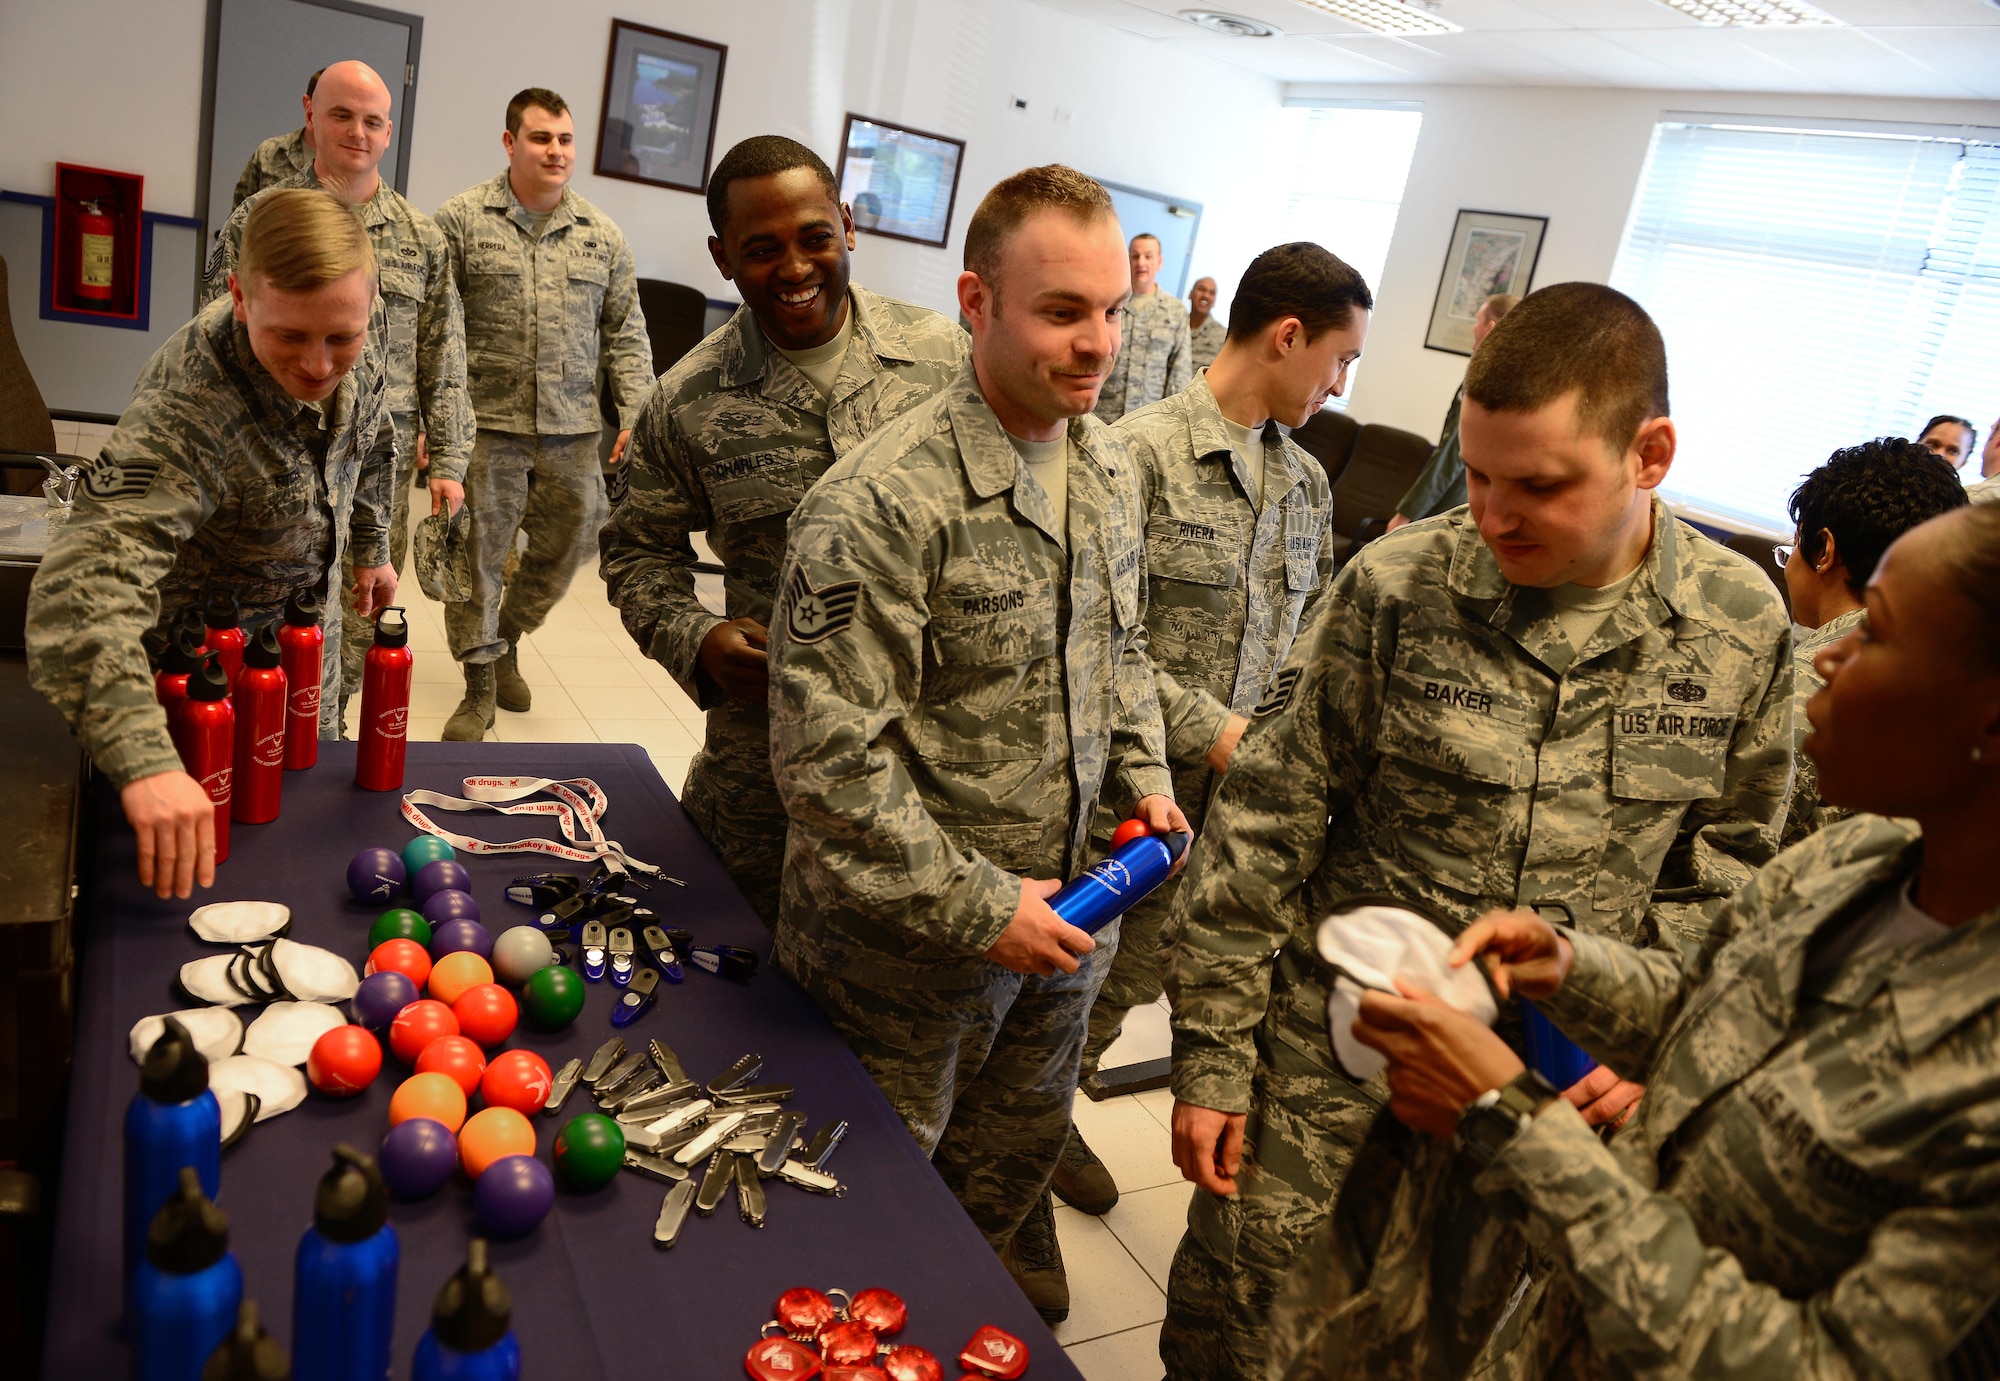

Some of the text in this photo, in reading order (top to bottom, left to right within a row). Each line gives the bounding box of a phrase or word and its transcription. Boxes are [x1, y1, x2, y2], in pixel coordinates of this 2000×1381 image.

[477, 241, 506, 251] HERRERA
[413, 264, 428, 275] FORC
[716, 453, 775, 477] CHARLES
[1179, 522, 1215, 541] RIVERA
[963, 590, 1024, 616] PARSONS
[1423, 681, 1493, 713] BAKER
[1621, 714, 1730, 738] U.S. AIR FORCE
[478, 778, 505, 787] drugs.
[545, 843, 564, 854] with
[565, 849, 592, 860] drugs.
